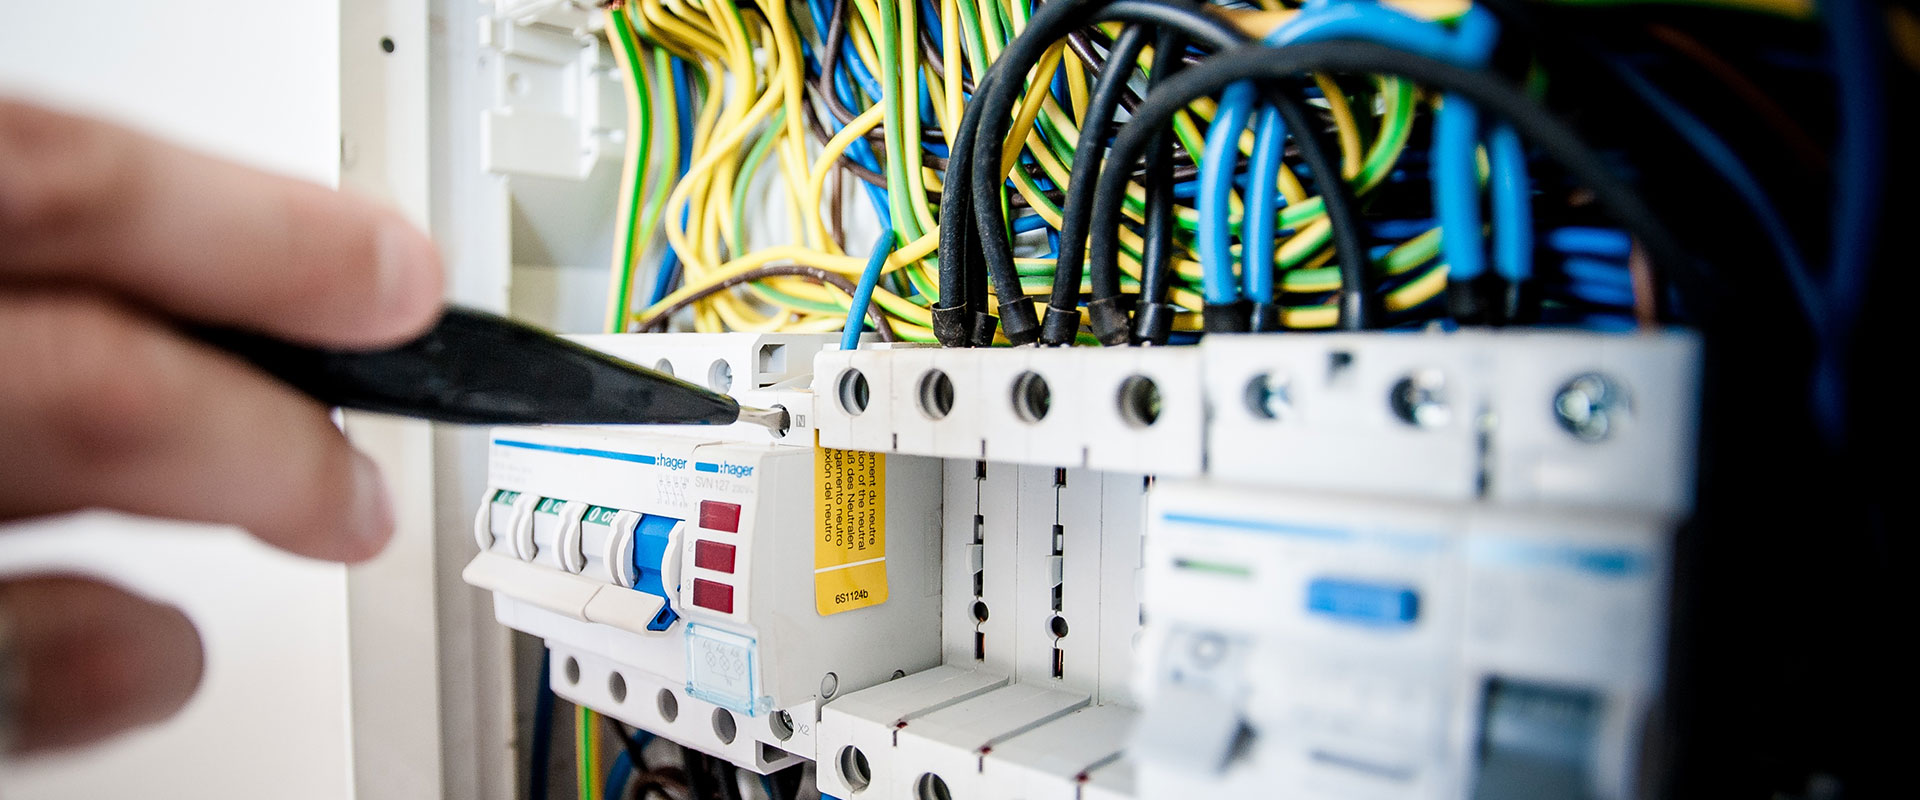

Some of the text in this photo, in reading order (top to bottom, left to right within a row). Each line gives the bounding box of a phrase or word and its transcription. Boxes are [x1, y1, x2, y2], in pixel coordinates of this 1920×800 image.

[796, 415, 806, 427] N
[695, 476, 713, 489] SVN
[715, 479, 730, 492] 127
[847, 468, 855, 490] des
[858, 474, 866, 486] of
[825, 482, 833, 500] del
[858, 489, 866, 508] the
[869, 490, 876, 505] du
[825, 503, 833, 543] neutro
[847, 493, 855, 550] Neutralen
[858, 511, 866, 551] neutral
[835, 589, 869, 604] 6S1124b
[798, 722, 810, 736] X2
